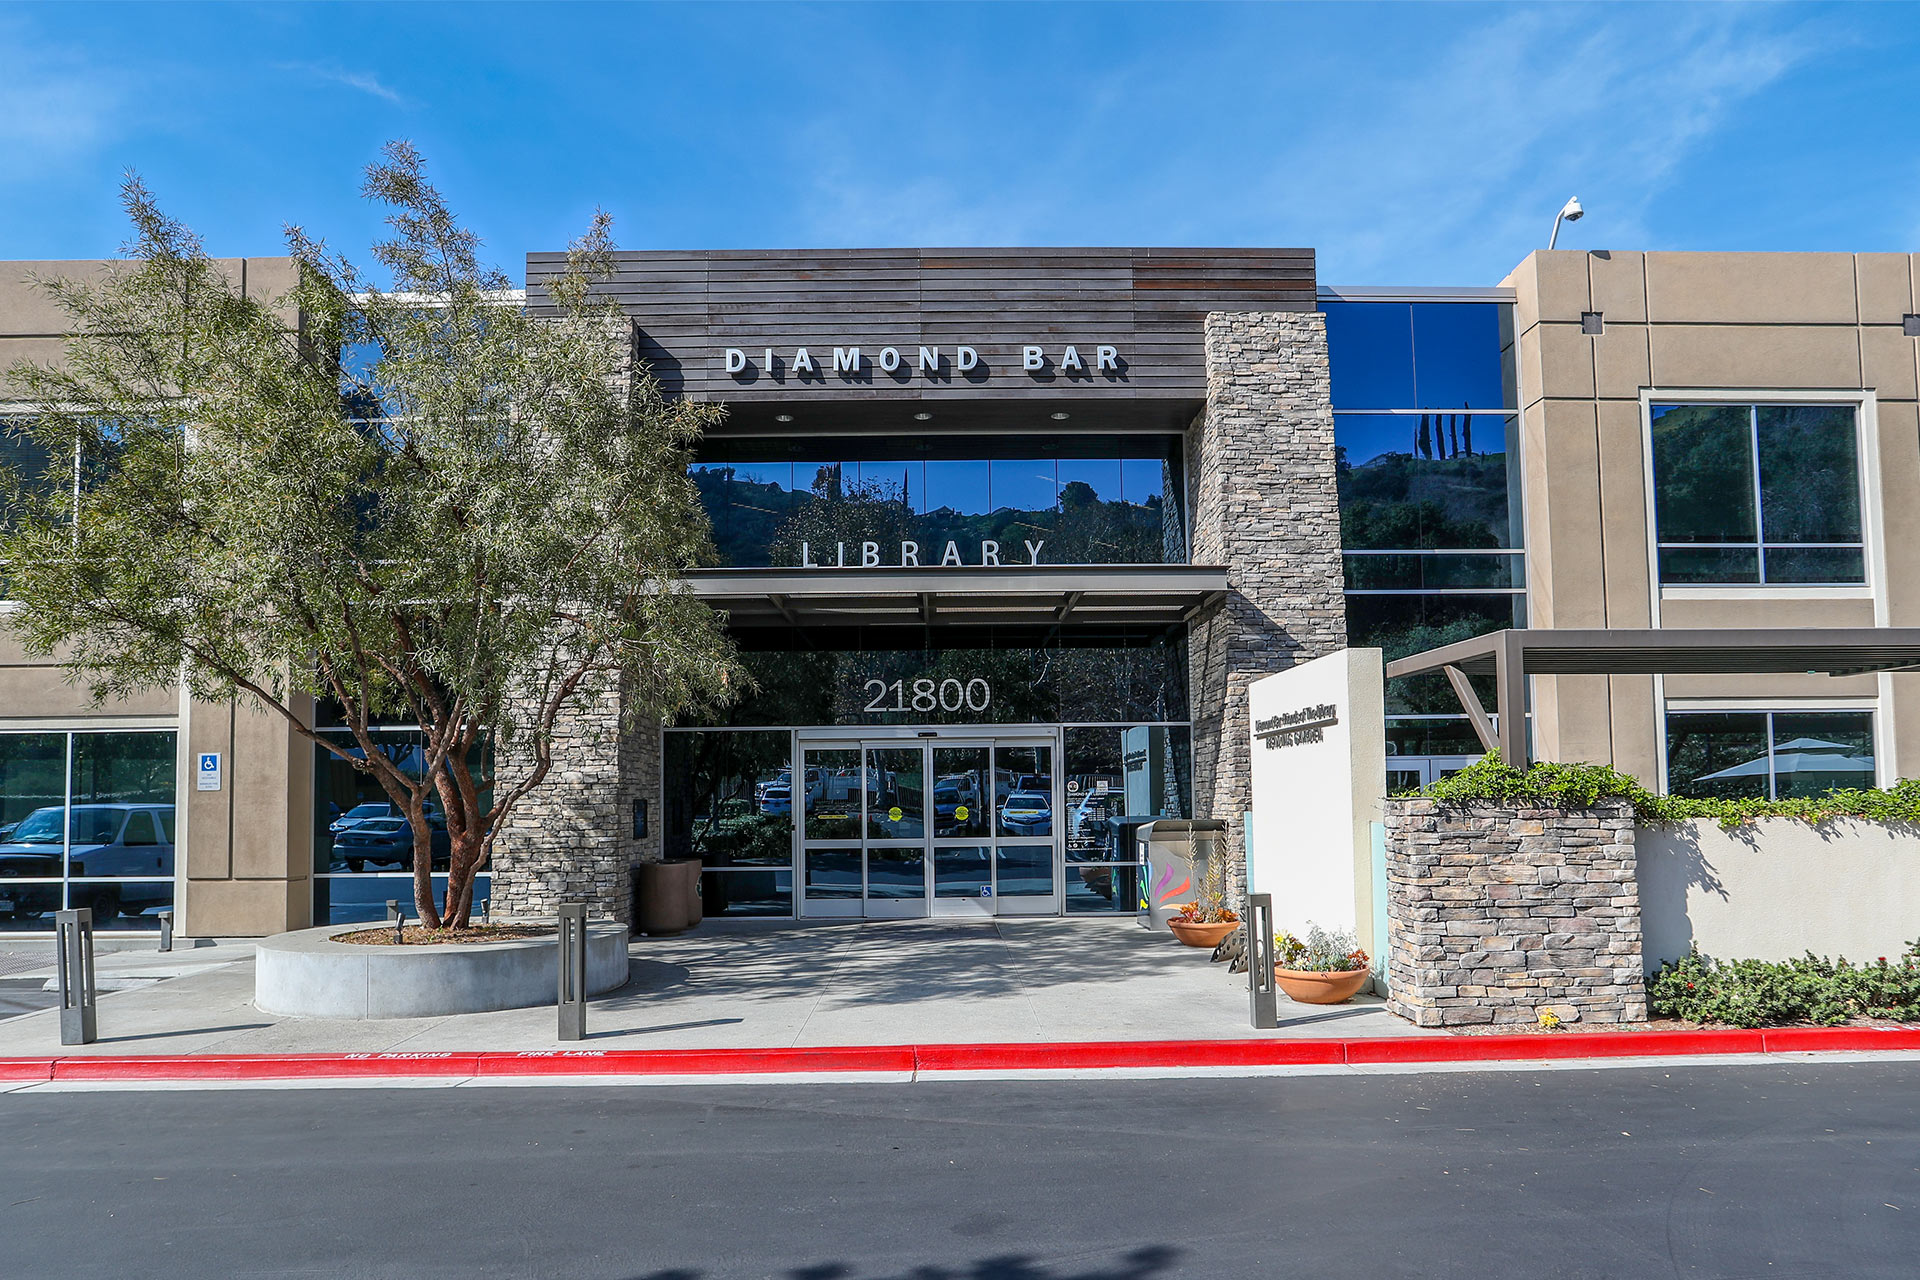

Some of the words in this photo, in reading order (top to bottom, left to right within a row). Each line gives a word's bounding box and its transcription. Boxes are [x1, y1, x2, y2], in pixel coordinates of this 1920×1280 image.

[725, 346, 979, 374] DIAMOND
[1023, 345, 1119, 371] BAR
[802, 540, 1045, 567] LIBRARY
[863, 678, 991, 712] 21800
[377, 1052, 452, 1060] PARKING
